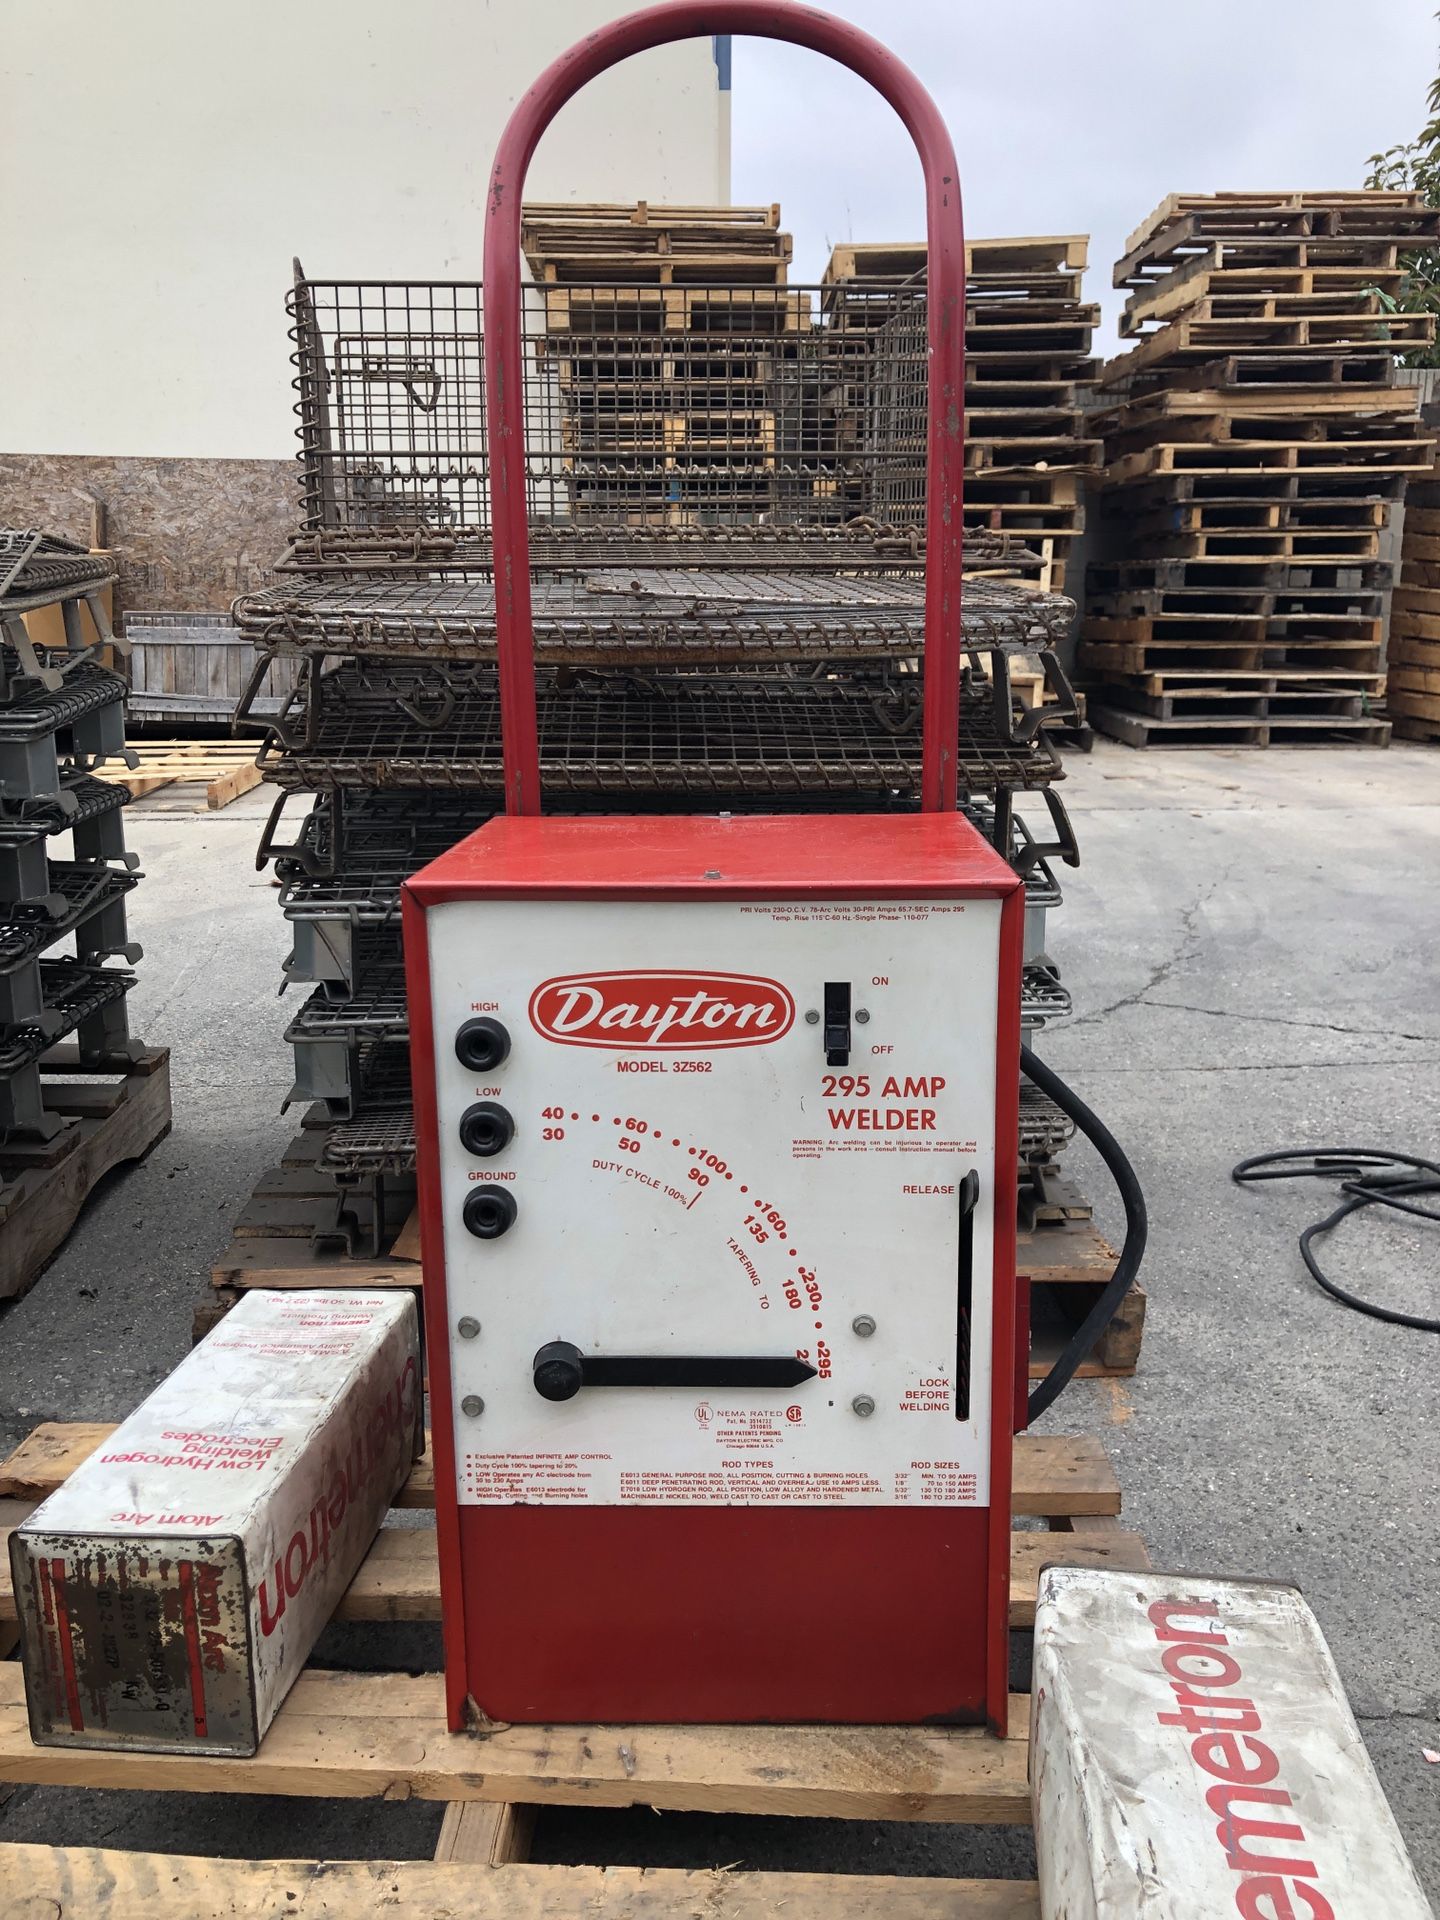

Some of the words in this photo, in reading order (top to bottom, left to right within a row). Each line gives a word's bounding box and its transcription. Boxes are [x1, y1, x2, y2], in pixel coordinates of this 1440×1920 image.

[872, 976, 888, 986] ON
[472, 1002, 498, 1012] HIGH
[552, 986, 777, 1043] Dayton
[872, 1045, 894, 1055] OFF
[618, 1061, 668, 1073] MODEL
[672, 1061, 712, 1073] 3Z562
[476, 1087, 502, 1097] LOW
[822, 1075, 870, 1098] 295
[880, 1076, 946, 1099] AMP
[828, 1108, 936, 1131] WELDER
[828, 1139, 838, 1147] Arc
[842, 1139, 866, 1147] welding
[870, 1139, 880, 1147] can
[884, 1139, 892, 1147] be
[896, 1139, 922, 1147] injurious
[926, 1139, 932, 1147] to
[936, 1139, 962, 1147] operator
[966, 1139, 976, 1147] and
[468, 1171, 518, 1181] GROUND
[592, 1159, 624, 1173] DUTY
[625, 1167, 661, 1189] CYCLE
[663, 1185, 688, 1206] 100%
[902, 1184, 954, 1195] RELEASE
[542, 1127, 565, 1141] 30
[618, 1136, 642, 1153] 50
[687, 1167, 710, 1187] 90
[743, 1215, 770, 1244] 135
[782, 1279, 802, 1310] 180
[541, 1106, 565, 1120] 40
[625, 1117, 648, 1134] 60
[698, 1149, 727, 1174] 100
[761, 1203, 787, 1232] 160
[801, 1271, 823, 1303] 230
[817, 1348, 832, 1379] 295
[726, 1236, 761, 1287] TAPERING
[759, 1294, 770, 1310] TO
[212, 1341, 258, 1349] Program
[260, 1342, 317, 1350] Assurance
[319, 1342, 355, 1350] Quality
[258, 1348, 307, 1356] Certified
[920, 1378, 950, 1388] LOCK
[906, 1390, 950, 1400] BEFORE
[900, 1402, 950, 1412] WELDING
[160, 1431, 284, 1449] Electrodes
[181, 1442, 272, 1460] Welding
[99, 1450, 215, 1470] Hydrogen
[722, 1460, 742, 1469] ROD
[744, 1460, 774, 1469] TYPES
[215, 1460, 267, 1471] Low
[475, 1462, 491, 1470] Duty
[491, 1462, 509, 1470] Cycle
[529, 1462, 555, 1470] tapering
[910, 1461, 932, 1470] ROD
[934, 1461, 960, 1470] SIZES
[522, 1472, 534, 1480] any
[109, 1512, 154, 1527] Arc
[157, 1514, 224, 1527] Atom
[200, 1630, 229, 1674] Arc
